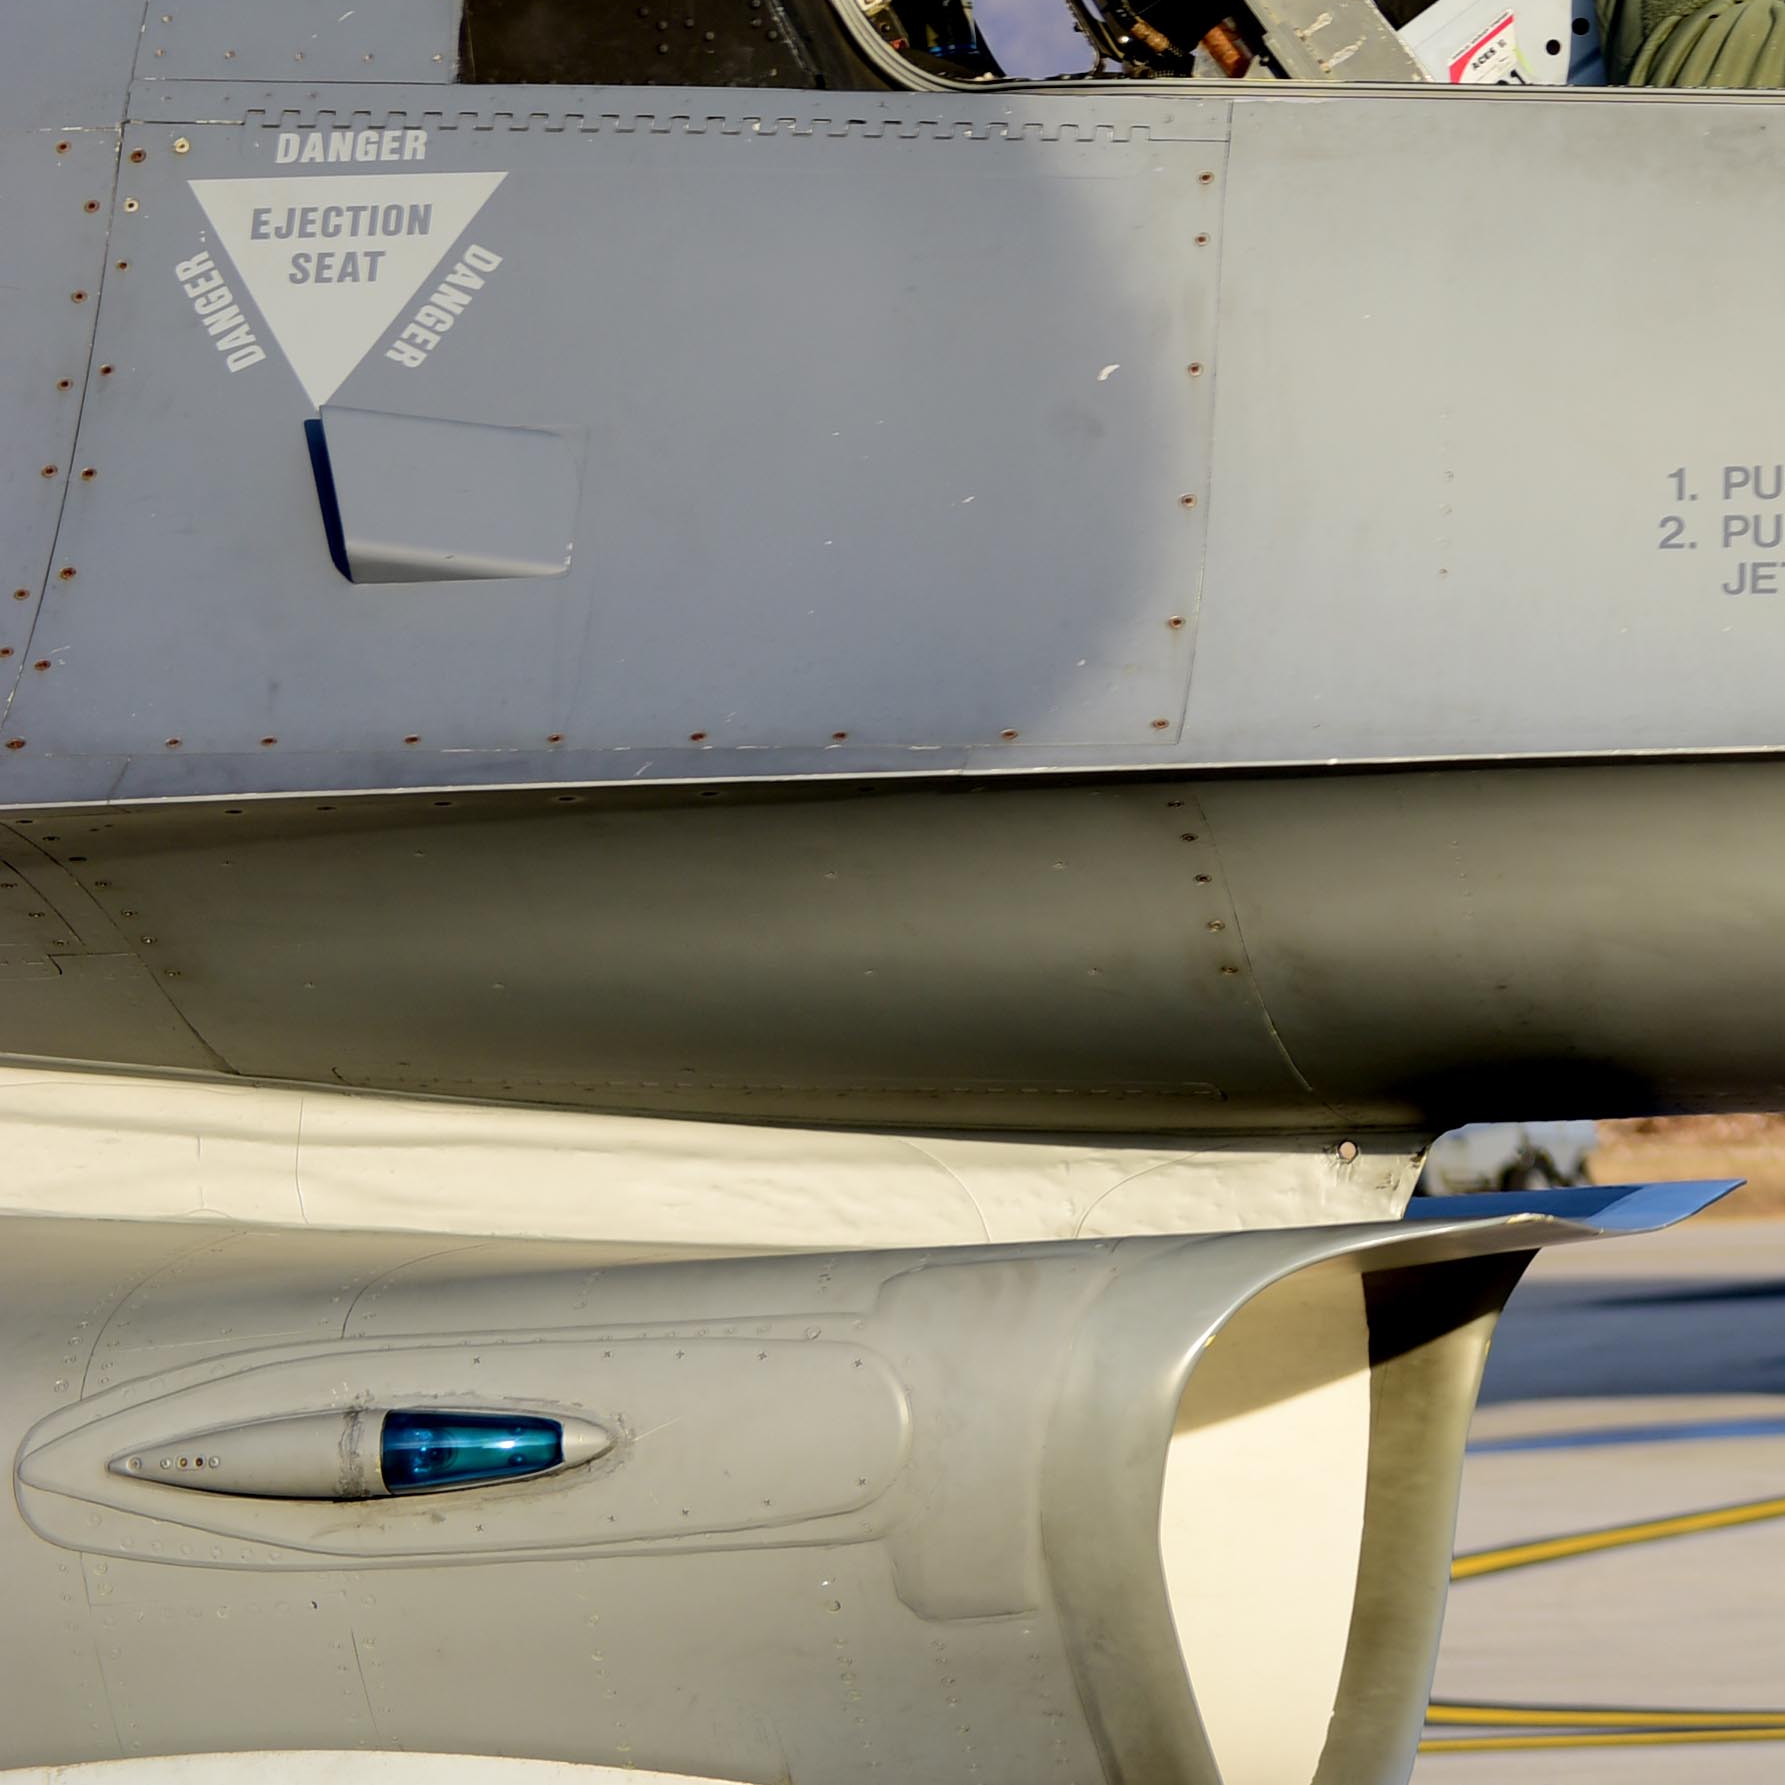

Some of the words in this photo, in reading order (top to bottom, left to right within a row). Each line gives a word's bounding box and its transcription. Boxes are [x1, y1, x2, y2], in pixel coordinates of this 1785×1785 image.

[1471, 47, 1496, 71] ACES
[276, 130, 428, 164] DANGER
[250, 203, 433, 241] EJECTION
[289, 250, 387, 285] SEAT
[175, 250, 267, 373] DANGER
[386, 244, 504, 368] DANGER
[1667, 468, 1700, 503] 1.
[1658, 516, 1699, 551] 2.
